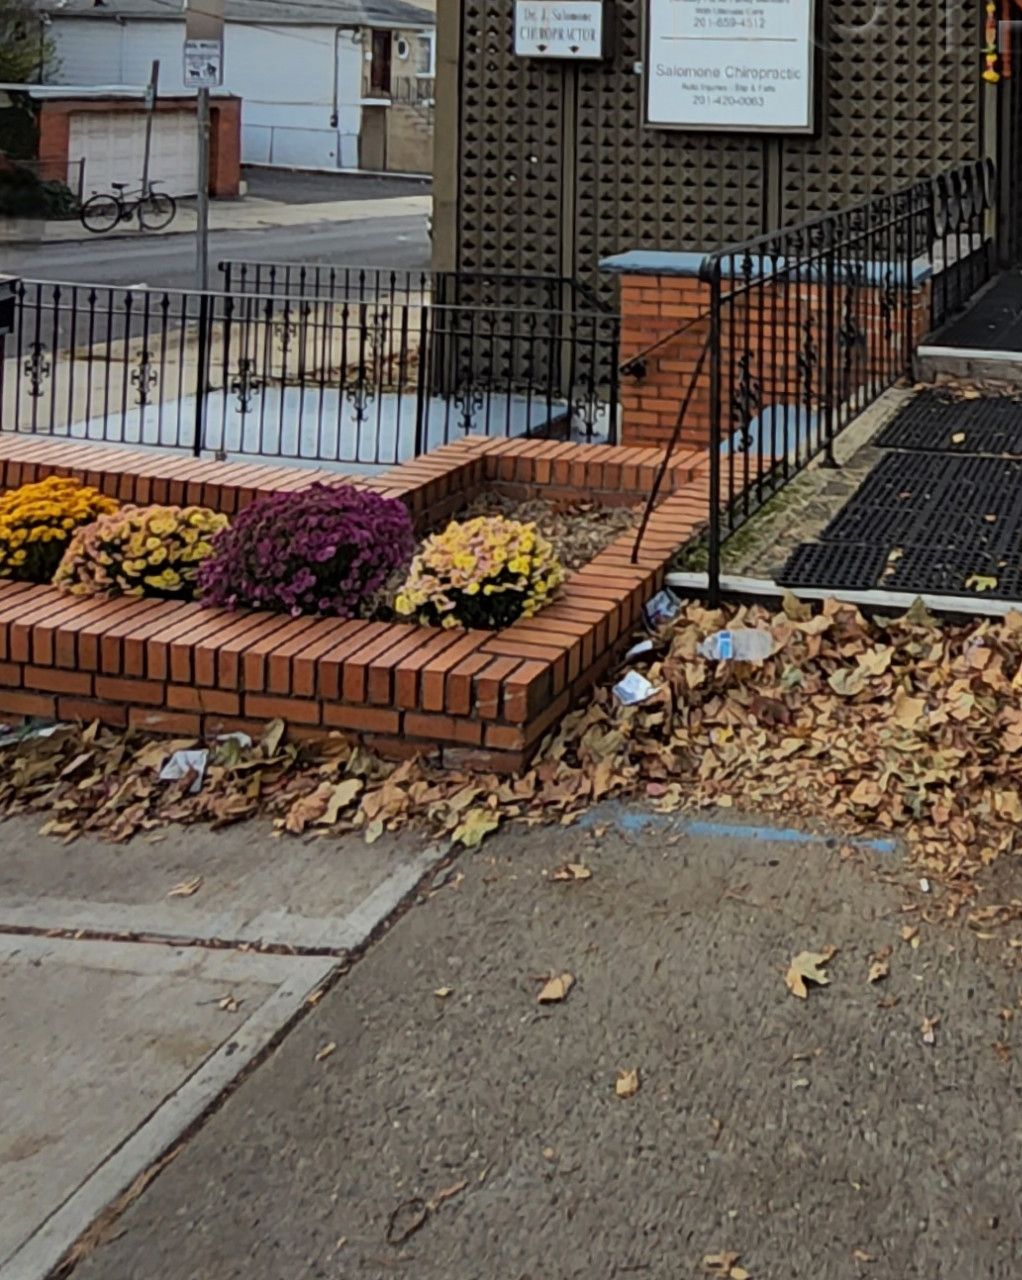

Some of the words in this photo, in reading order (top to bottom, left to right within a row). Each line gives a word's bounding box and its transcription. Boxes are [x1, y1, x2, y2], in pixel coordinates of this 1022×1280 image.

[520, 26, 596, 41] CHIROPRACTOR
[656, 63, 721, 78] Salomone
[725, 65, 802, 80] Chiropractic
